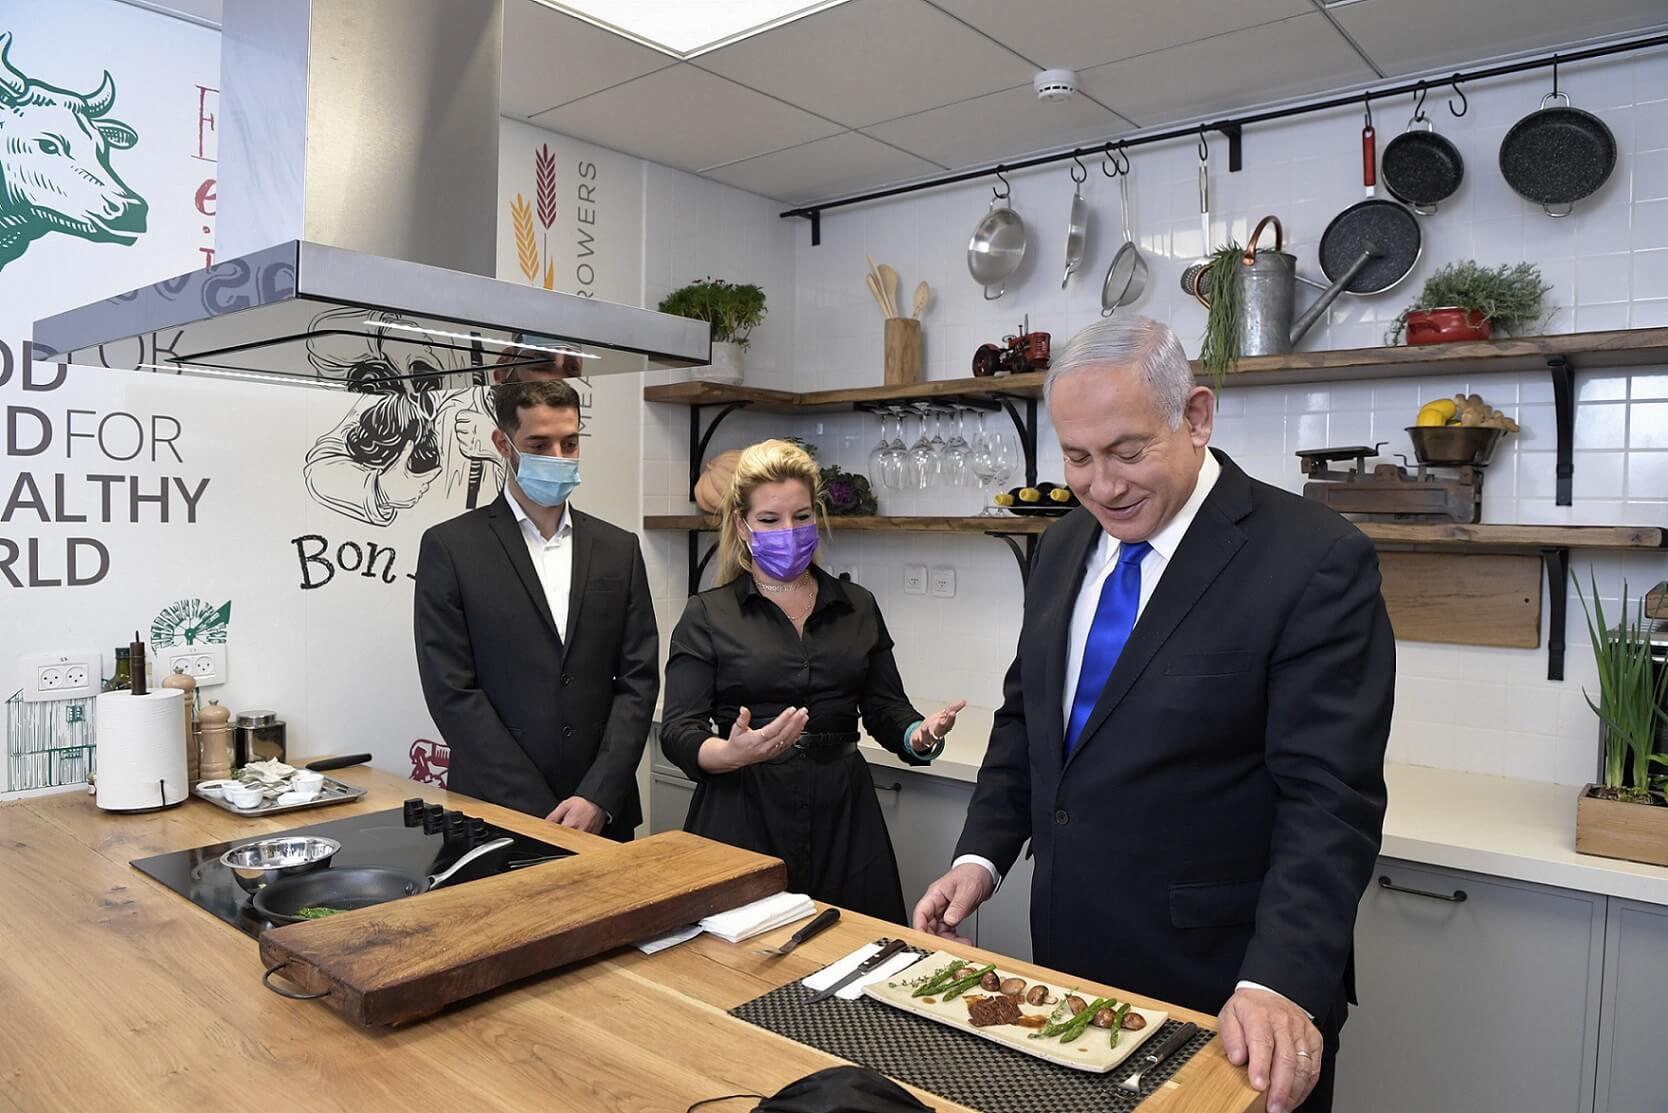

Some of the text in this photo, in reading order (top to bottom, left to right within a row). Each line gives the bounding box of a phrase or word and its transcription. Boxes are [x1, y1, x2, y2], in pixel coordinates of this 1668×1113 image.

[67, 409, 183, 463] FOR
[0, 472, 211, 523] ALTHY
[291, 534, 397, 590] Bon
